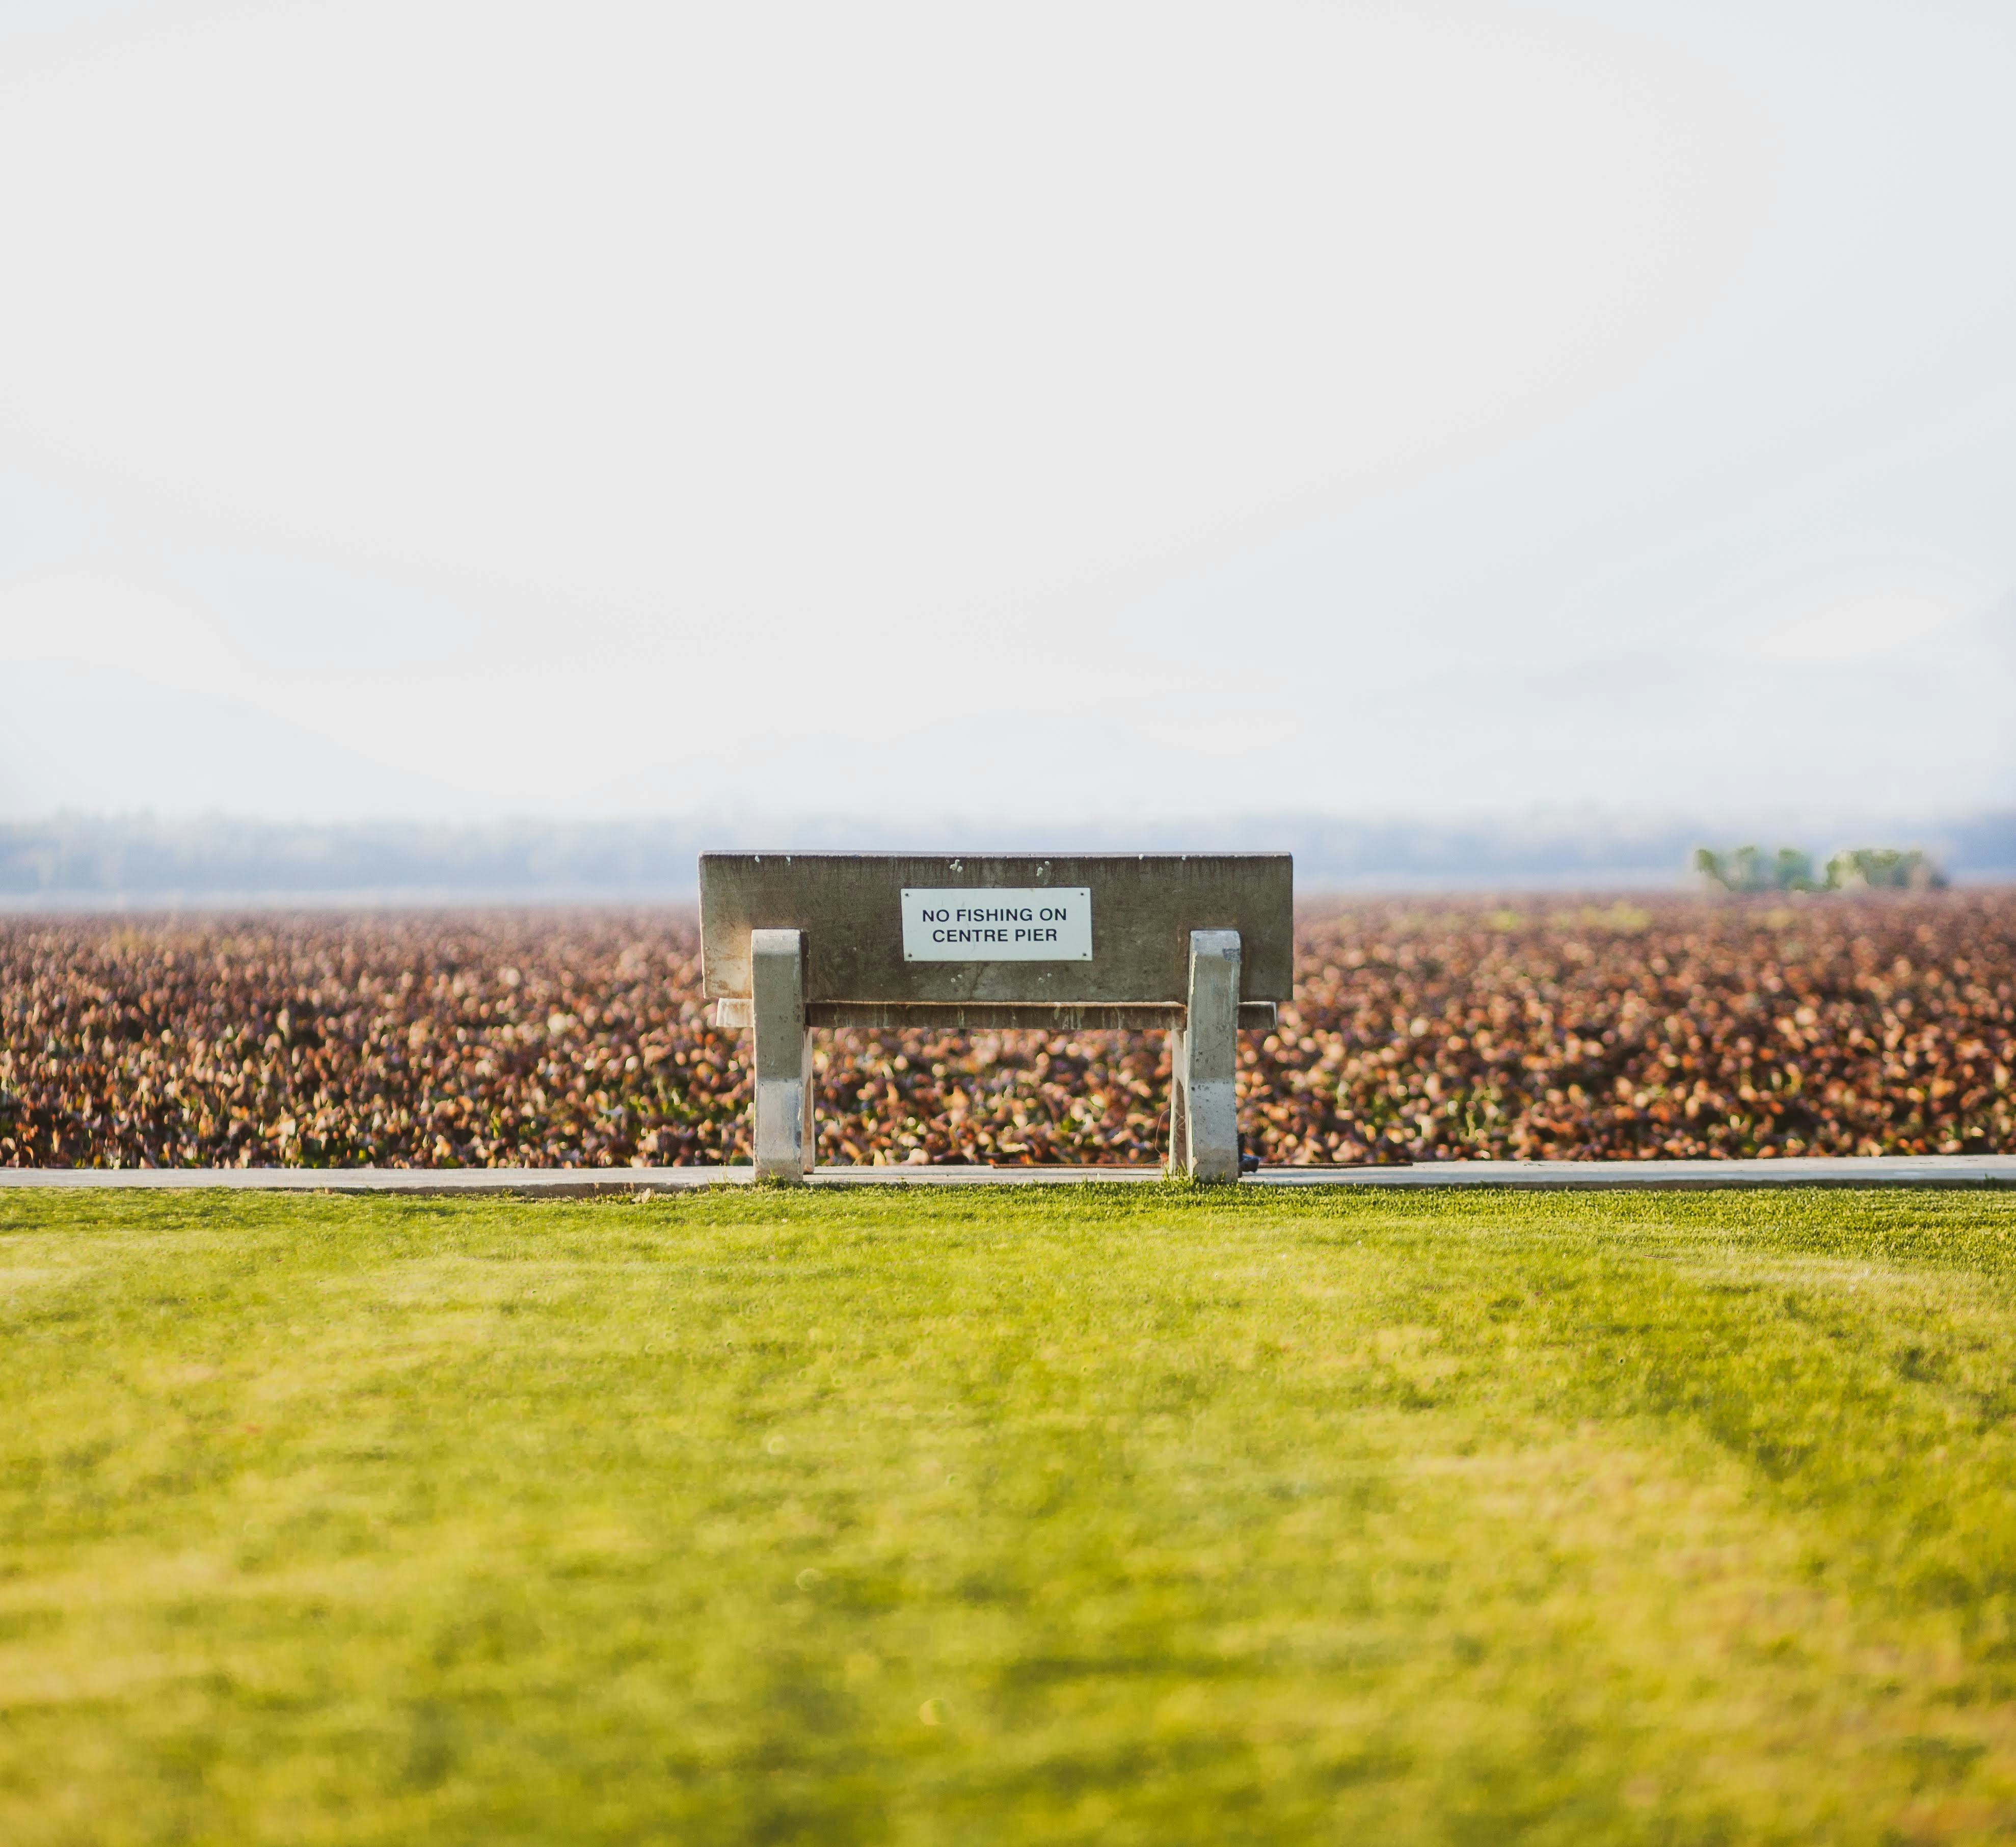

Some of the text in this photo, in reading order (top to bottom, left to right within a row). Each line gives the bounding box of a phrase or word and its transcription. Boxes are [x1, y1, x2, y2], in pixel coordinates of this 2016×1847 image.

[922, 908, 1066, 922] NO FISHING ON
[932, 928, 1057, 943] CENTRE PIER
